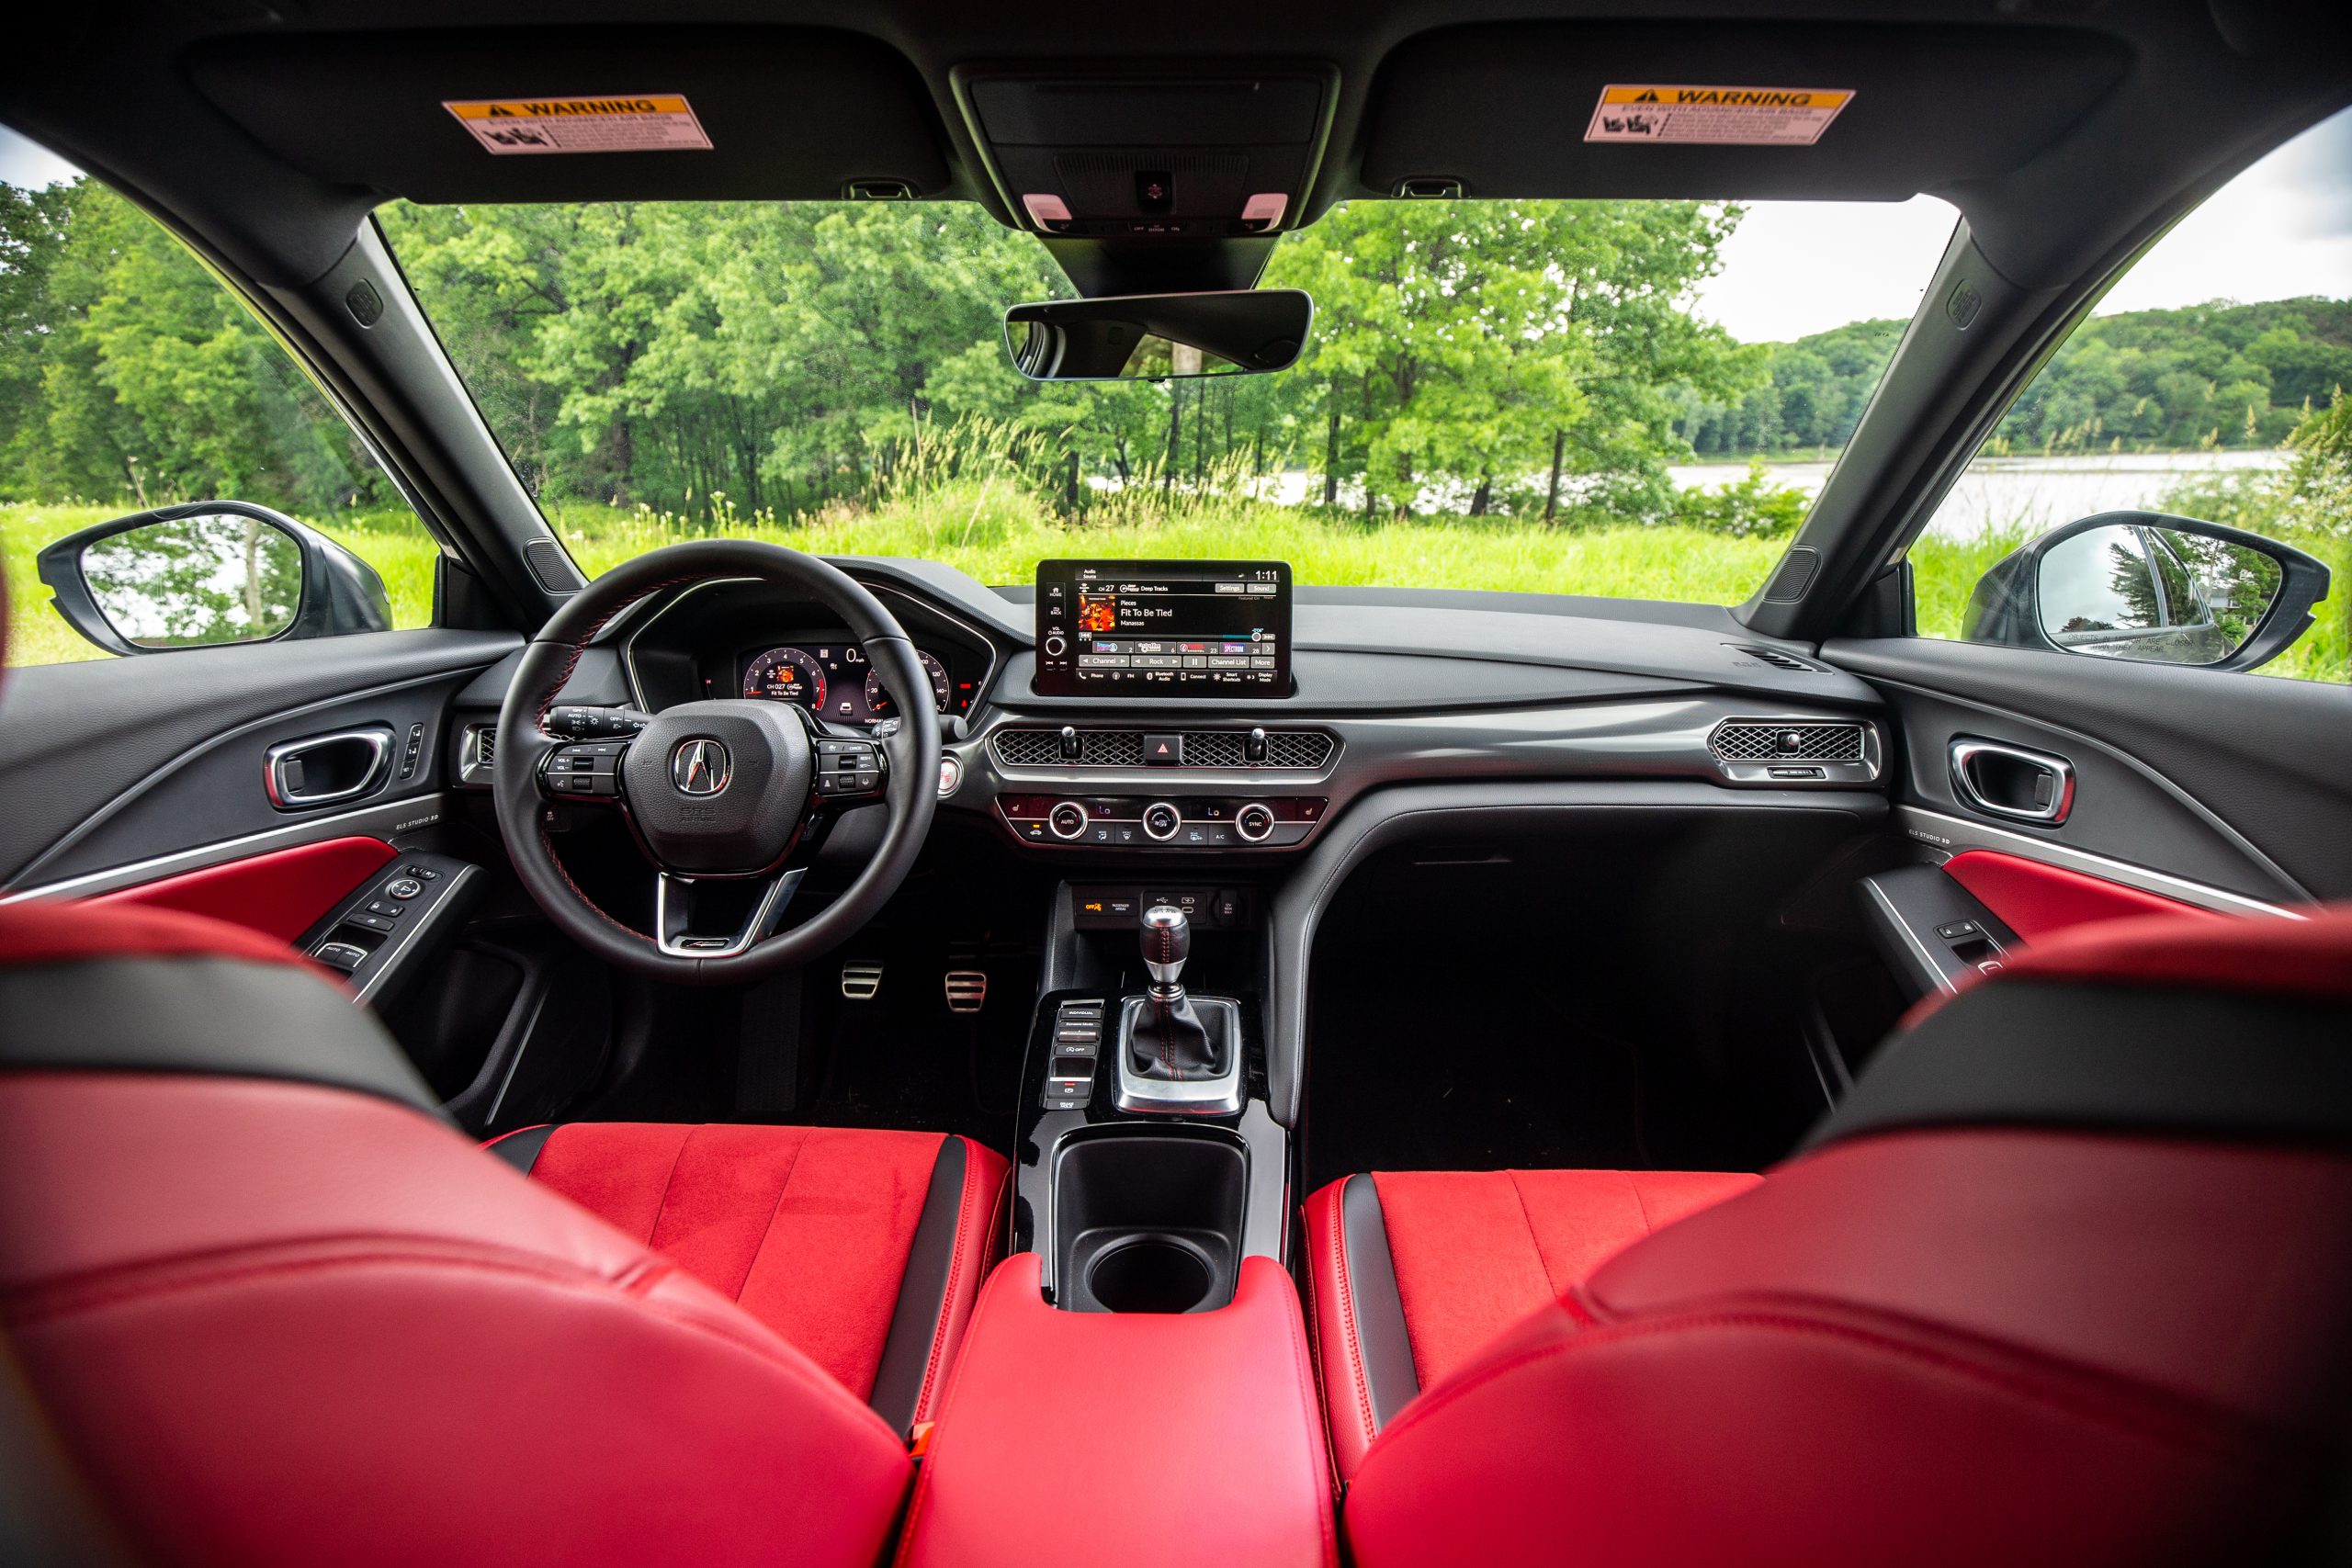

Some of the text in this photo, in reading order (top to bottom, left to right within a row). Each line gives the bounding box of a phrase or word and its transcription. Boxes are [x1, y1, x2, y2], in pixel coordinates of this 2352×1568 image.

[1678, 89, 1812, 106] WARNING
[522, 98, 657, 116] WARNING
[1255, 570, 1277, 581] 1:11
[1120, 609, 1172, 617] Fit To Be Tied
[2067, 634, 2098, 642] OBJECTS
[2165, 639, 2194, 648] CLOSER
[845, 648, 857, 663] 0
[1099, 806, 1111, 815] Lo
[1207, 807, 1220, 817] Lo
[396, 822, 407, 830] ELS
[408, 817, 429, 827] STUDIO
[1919, 831, 1940, 841] STUDIO
